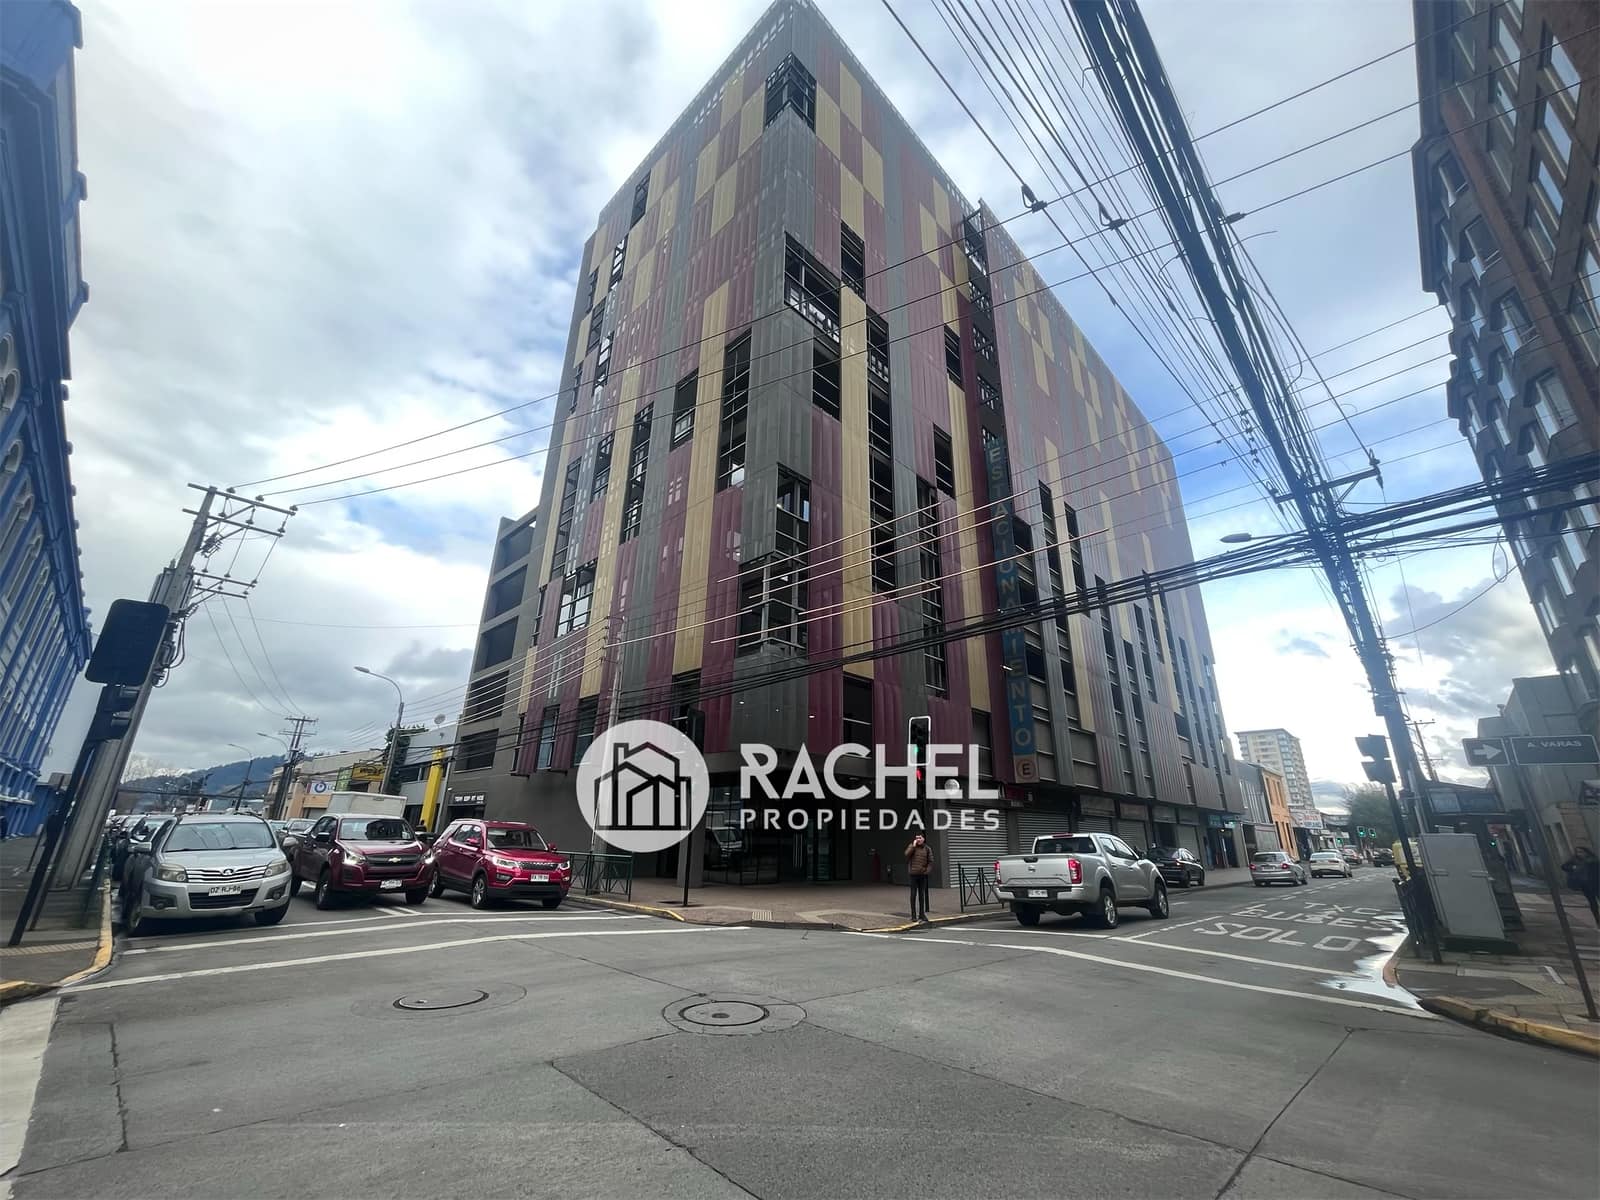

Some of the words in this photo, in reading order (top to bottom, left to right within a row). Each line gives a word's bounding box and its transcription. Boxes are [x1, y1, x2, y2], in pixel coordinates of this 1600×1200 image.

[989, 447, 1032, 747] ESTACIONAIENTO
[1022, 763, 1031, 775] E
[1193, 922, 1363, 951] SOLO
